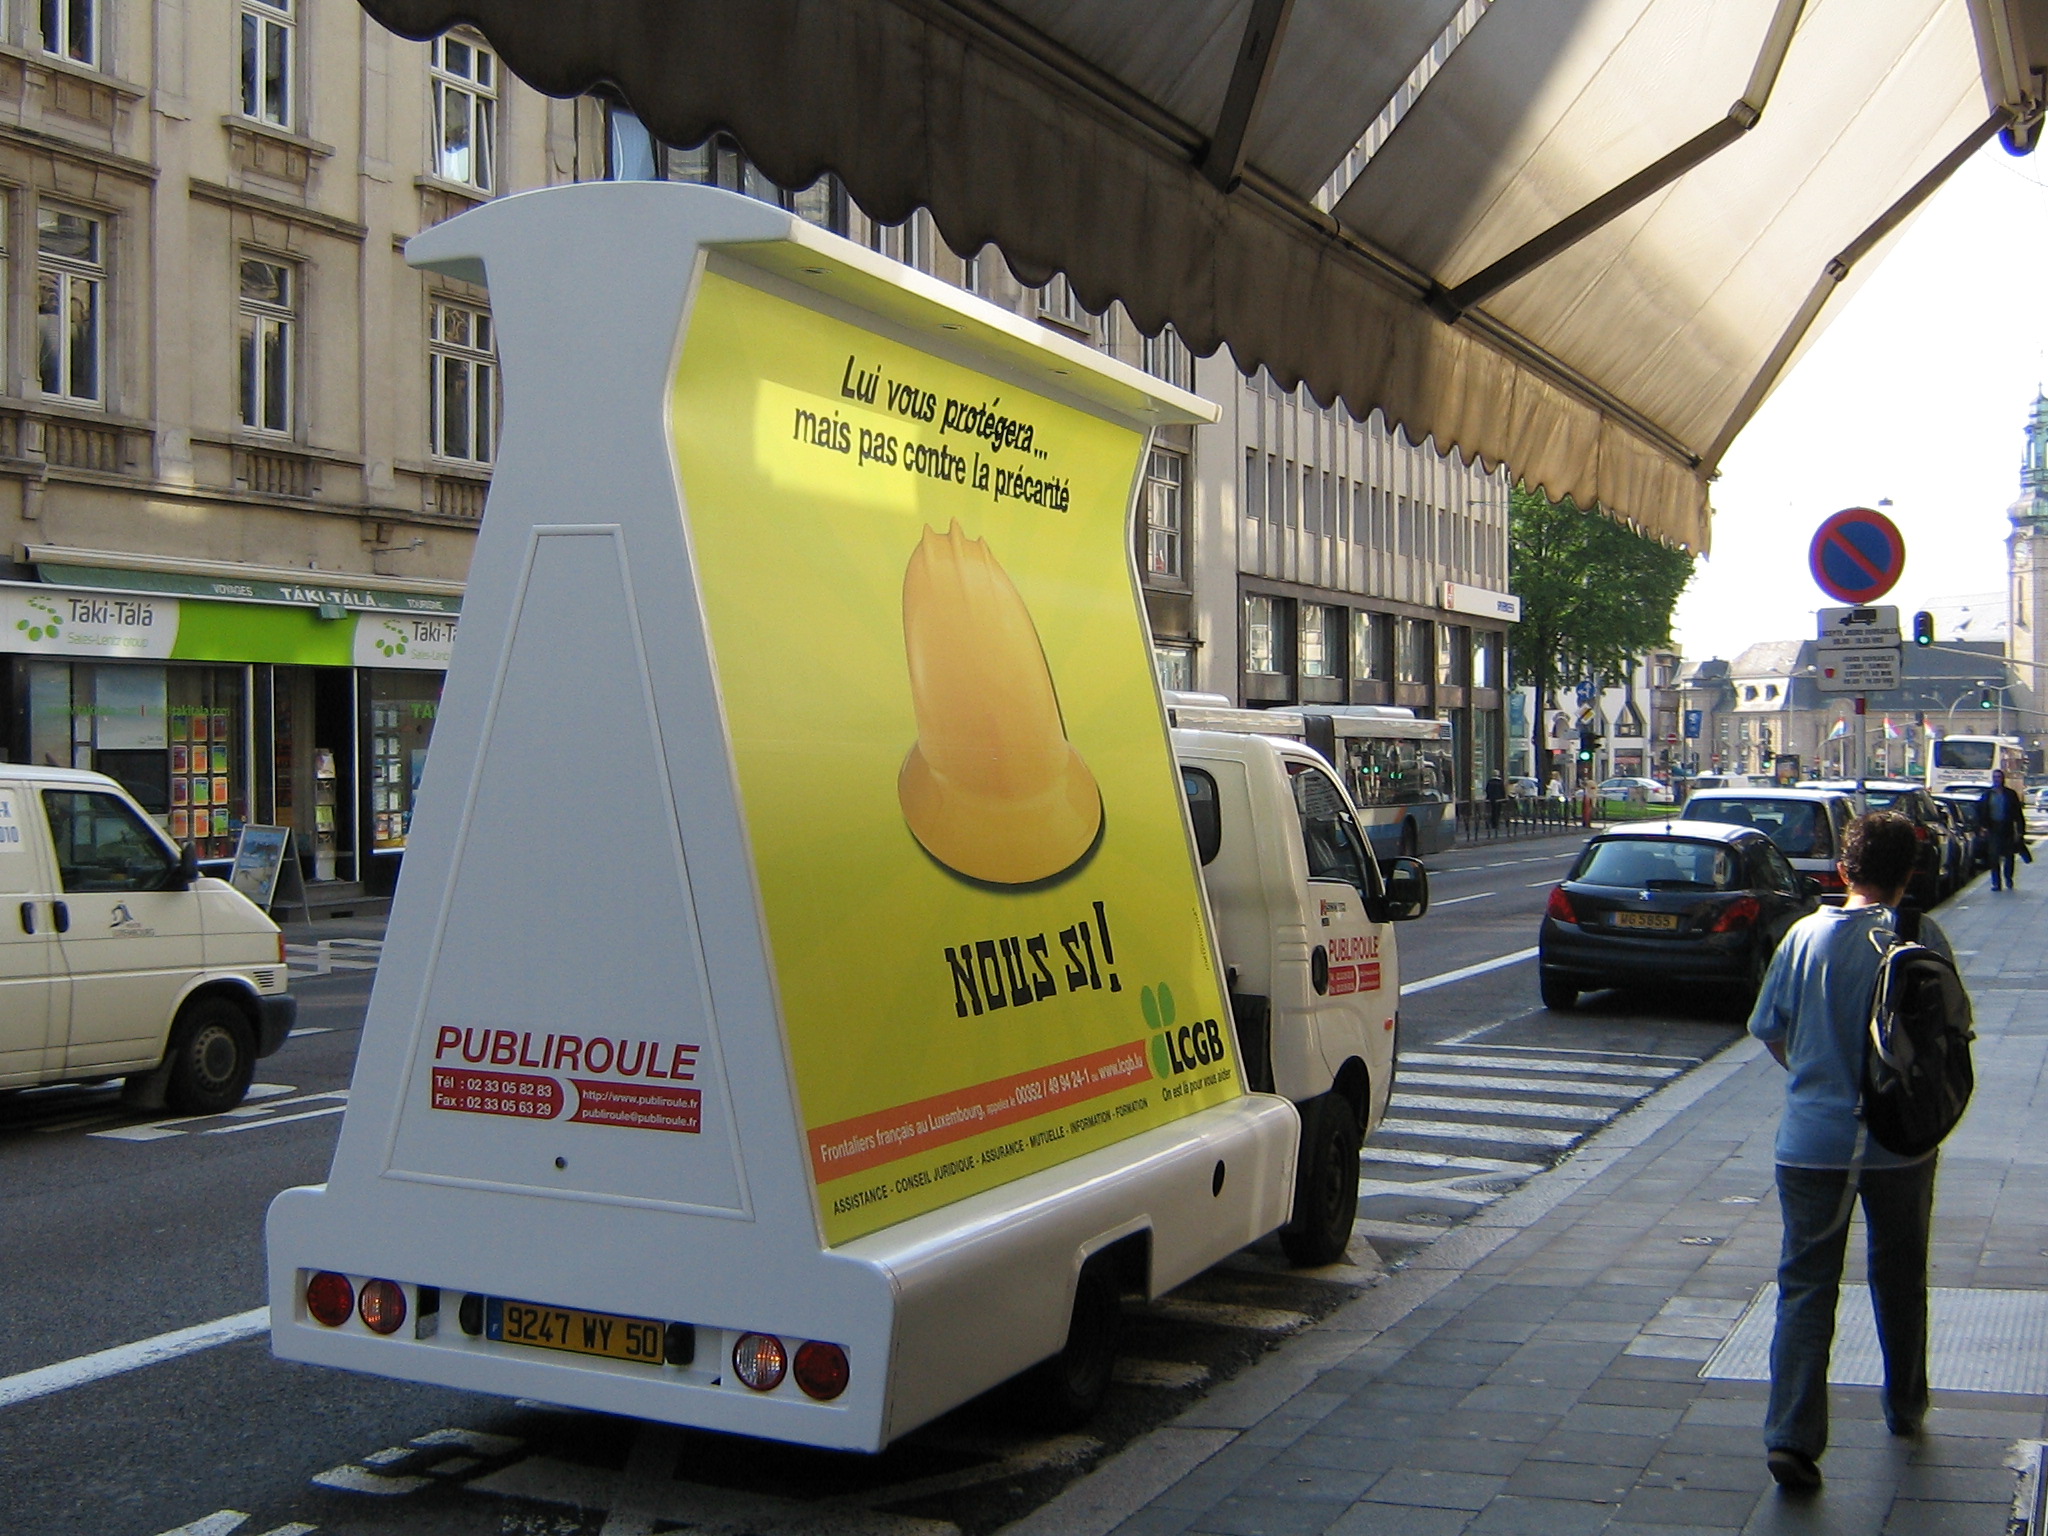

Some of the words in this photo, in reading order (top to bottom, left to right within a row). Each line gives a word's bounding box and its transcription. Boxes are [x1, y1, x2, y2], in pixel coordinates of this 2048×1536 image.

[841, 355, 881, 405] Lui
[887, 379, 937, 423] vous
[794, 408, 851, 454] mais
[858, 426, 898, 466] pas
[903, 441, 966, 485] contre
[972, 452, 990, 491] la
[994, 465, 1070, 513] précarité
[68, 598, 154, 627] Táki-Tálá
[944, 933, 1057, 1018] NOUS
[435, 1025, 700, 1081] PUBLIROULE
[1165, 1019, 1224, 1076] LCGB
[435, 1093, 457, 1107] Fax
[466, 1096, 481, 1109] 02
[484, 1098, 499, 1111] 33
[501, 1099, 516, 1112] 05
[519, 1101, 534, 1114] 63
[536, 1102, 552, 1115] 29
[436, 1076, 454, 1089] Tél
[467, 1078, 482, 1091] 02
[484, 1079, 499, 1092] 33
[502, 1081, 517, 1094] 05
[520, 1083, 535, 1096] 82
[537, 1084, 552, 1098] 83
[1162, 1087, 1172, 1102] On
[820, 1133, 876, 1163] Frontaliers
[876, 1121, 916, 1146] français
[916, 1118, 929, 1133] au
[834, 1184, 889, 1215] ASSISTANCE
[895, 1170, 932, 1194] CONSEIL
[933, 1155, 975, 1181] JURIDIQUE
[981, 1139, 1024, 1164] ASSURANCE
[1029, 1125, 1065, 1148] MUTUELLE
[1069, 1109, 1112, 1134] INFORMATION
[1116, 1097, 1149, 1118] FORMATION
[508, 1306, 570, 1344] 9247
[583, 1316, 614, 1351] WY
[625, 1323, 658, 1358] 50
